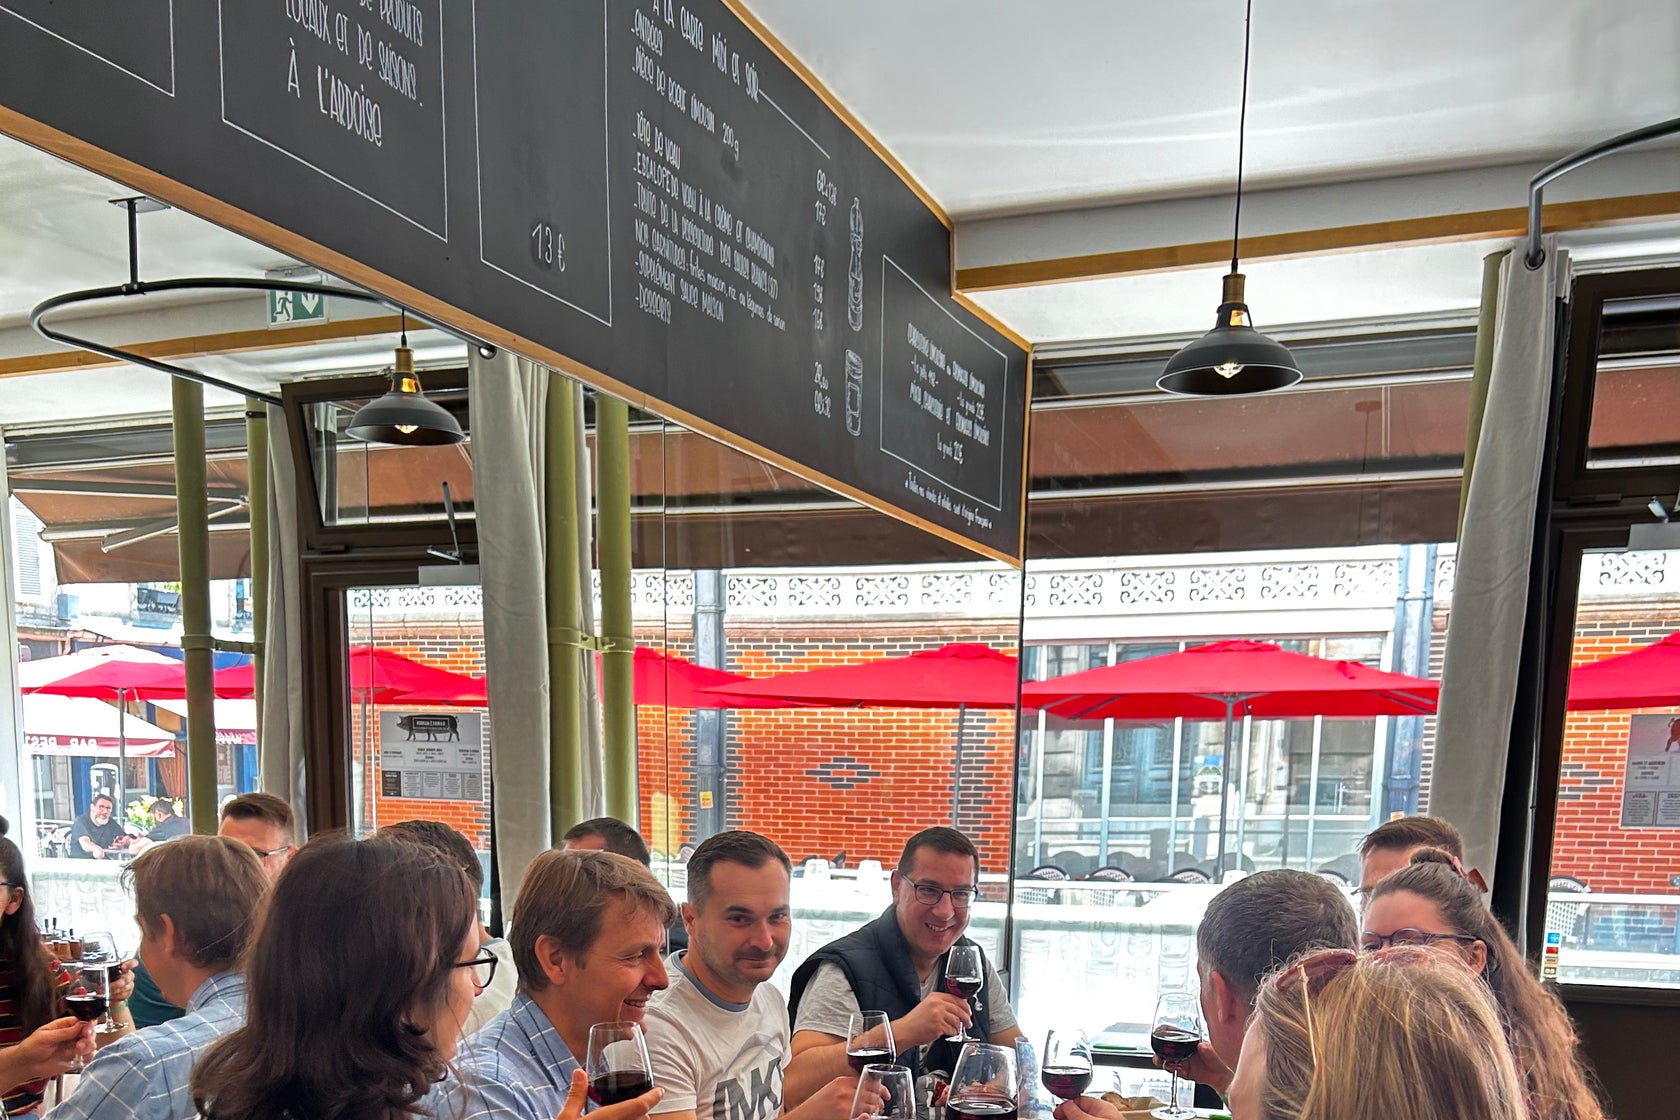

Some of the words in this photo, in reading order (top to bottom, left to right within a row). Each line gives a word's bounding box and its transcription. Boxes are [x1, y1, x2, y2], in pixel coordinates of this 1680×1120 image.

[335, 12, 349, 56] ET
[357, 23, 373, 71] DE
[680, 6, 705, 52] CARTE
[287, 36, 301, 99] À
[317, 64, 383, 147] L'ARDOISE
